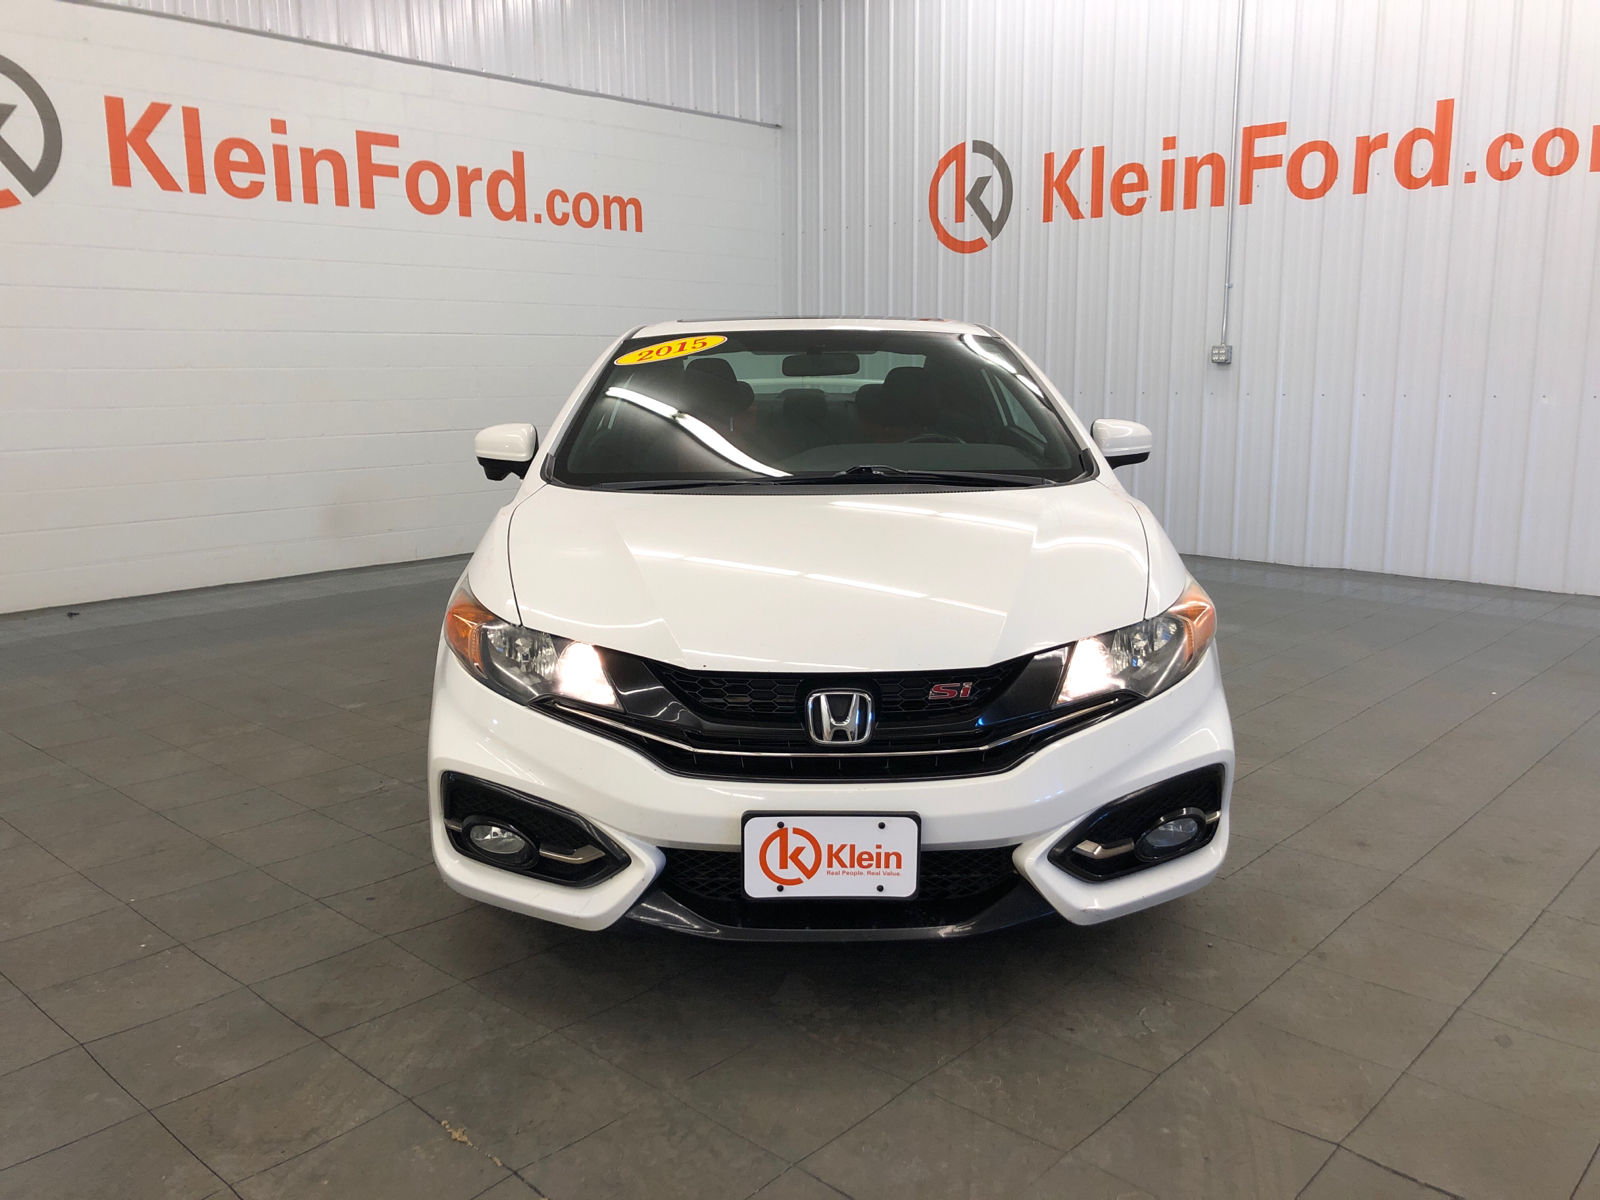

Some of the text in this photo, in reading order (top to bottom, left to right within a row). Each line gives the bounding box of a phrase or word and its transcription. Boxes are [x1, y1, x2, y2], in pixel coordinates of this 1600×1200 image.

[103, 94, 644, 233] KleinFord.com
[1042, 97, 1600, 223] KleinFord.co
[637, 338, 708, 362] 2015
[928, 682, 973, 699] Si
[827, 844, 903, 869] Klein
